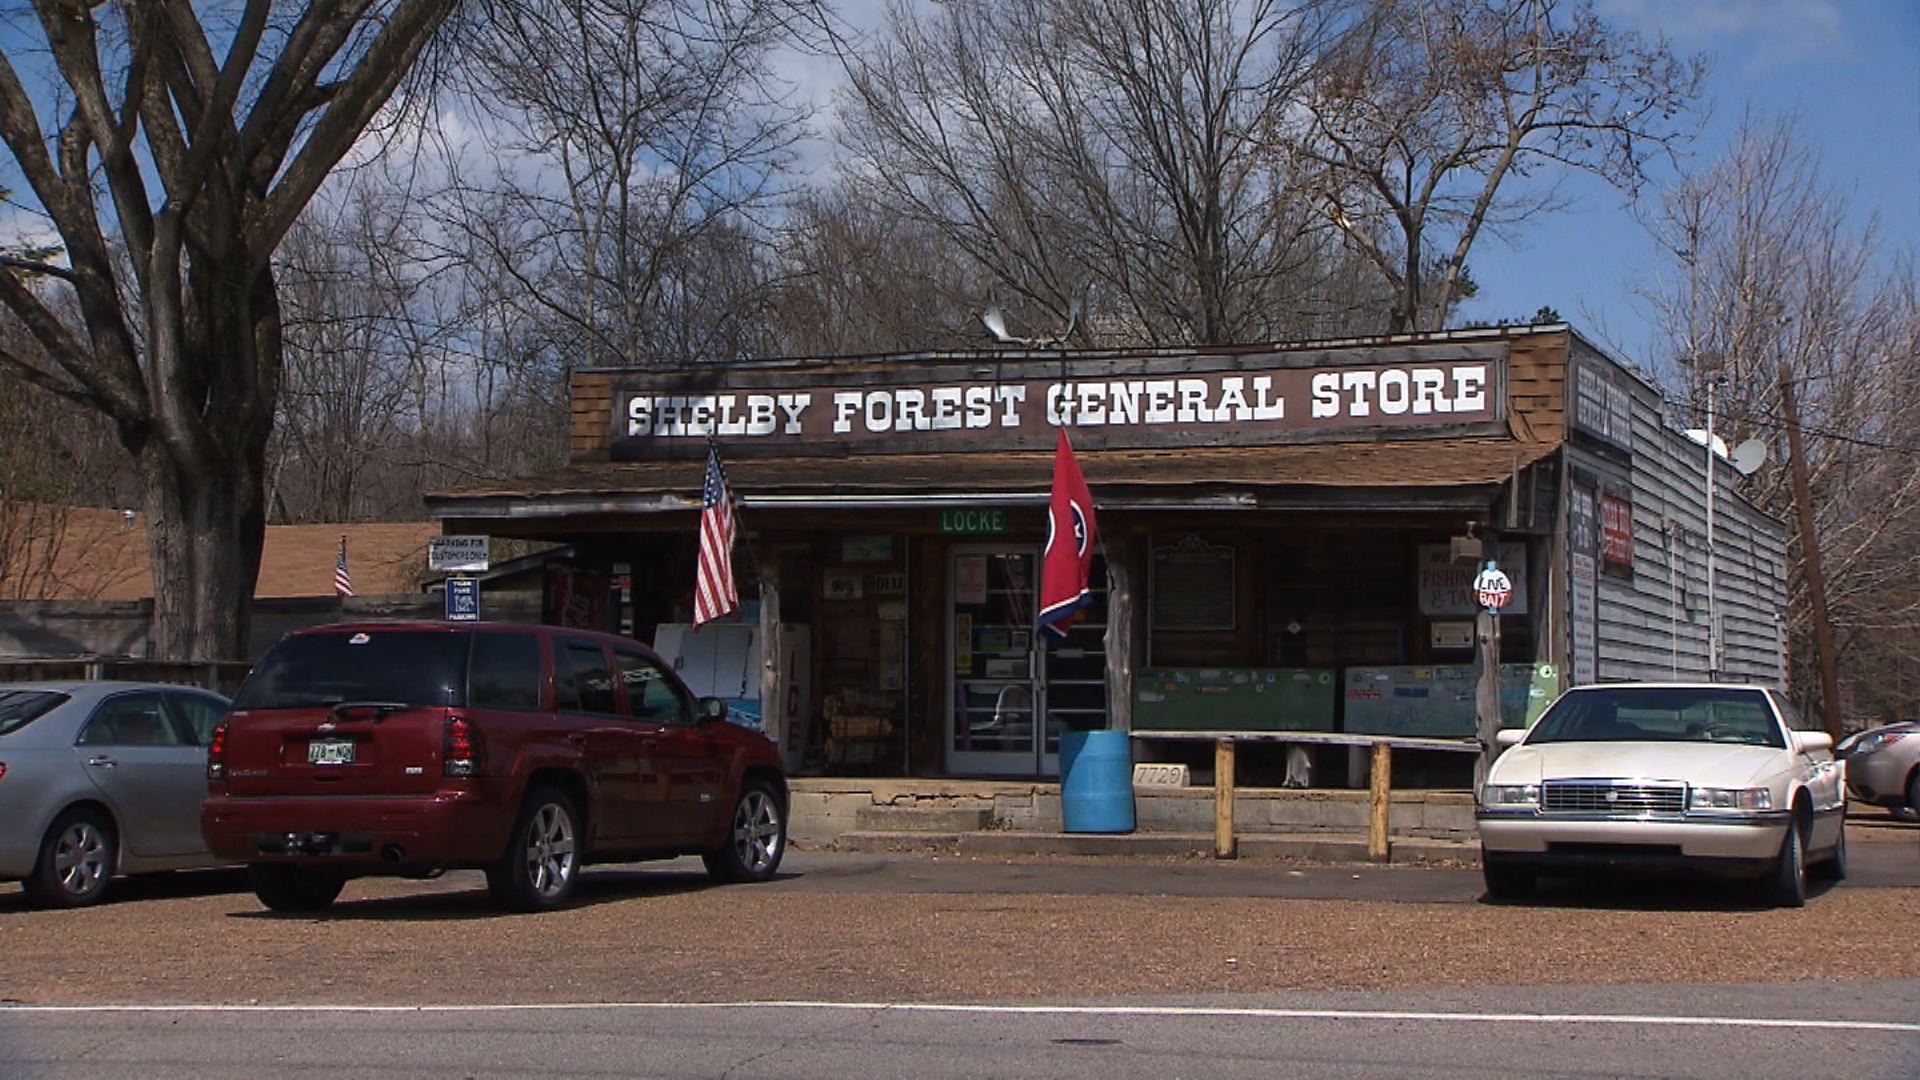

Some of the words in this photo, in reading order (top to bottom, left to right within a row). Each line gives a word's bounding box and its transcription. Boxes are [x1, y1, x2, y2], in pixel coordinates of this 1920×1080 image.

[628, 394, 811, 436] SHELBY
[833, 385, 1026, 433] FOREST
[1047, 376, 1285, 427] GENERAL
[1311, 366, 1486, 419] STORE
[943, 511, 1003, 530] LOCKE
[1479, 576, 1507, 591] LIVE
[1479, 592, 1508, 608] BAIT
[1138, 767, 1181, 784] 7729
